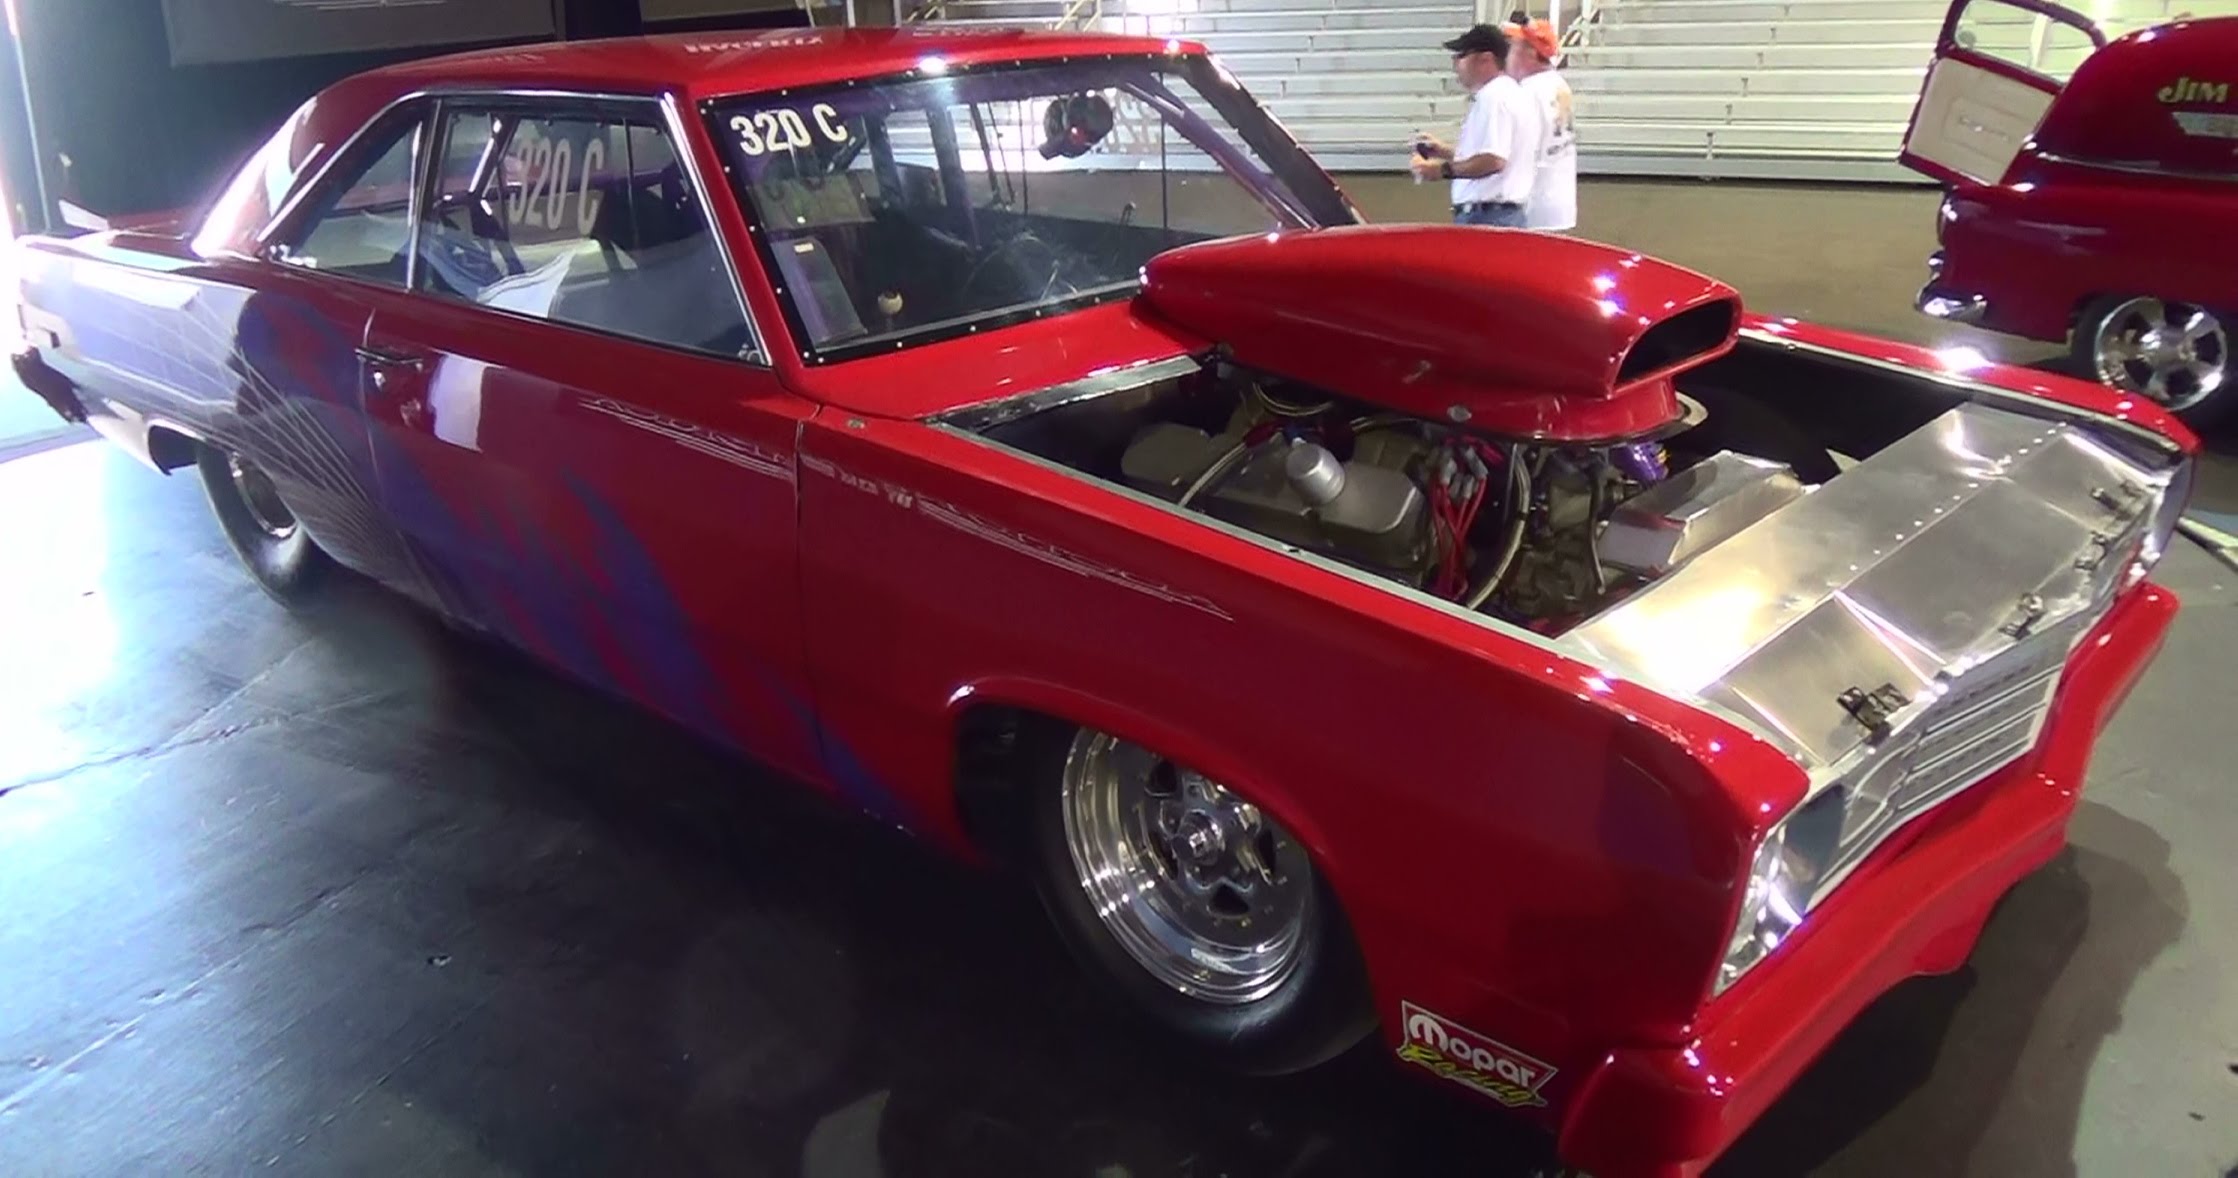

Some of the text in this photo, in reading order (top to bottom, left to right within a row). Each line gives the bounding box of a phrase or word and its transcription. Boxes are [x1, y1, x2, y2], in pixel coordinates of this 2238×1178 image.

[2157, 77, 2229, 103] JIM
[730, 103, 848, 156] 320 C
[509, 137, 604, 236] 320 C
[1409, 1013, 1536, 1087] Mopar
